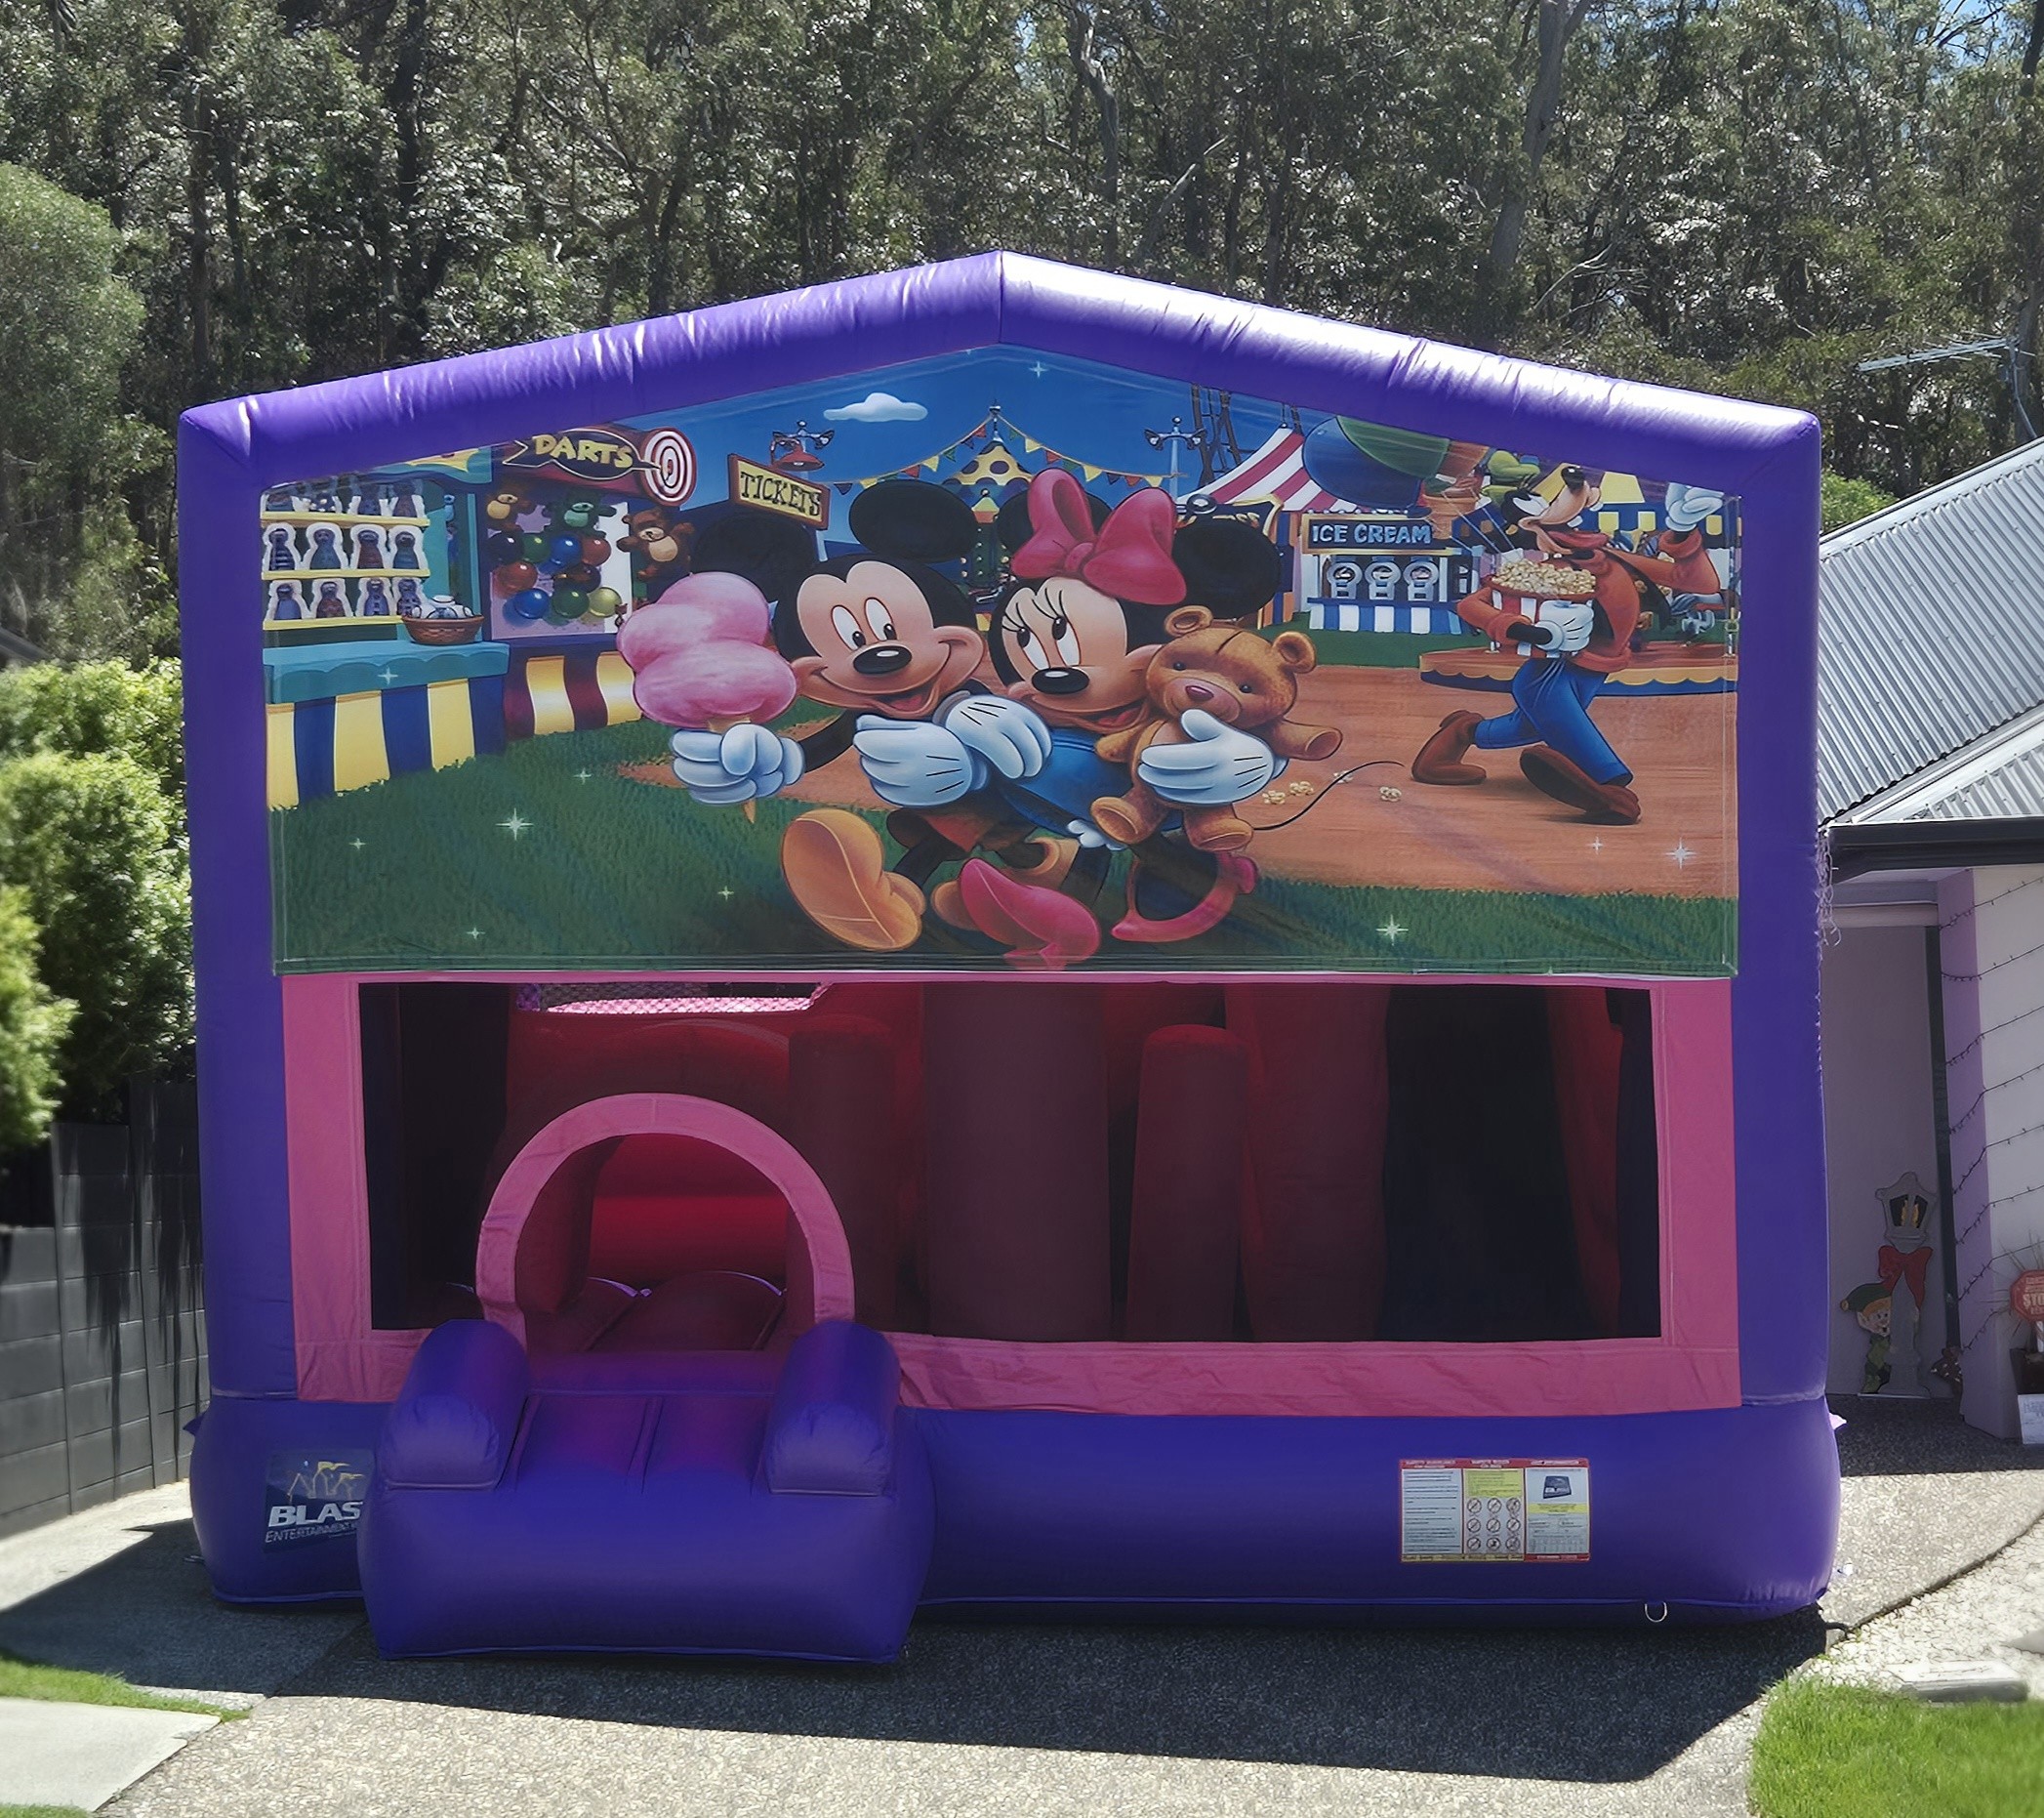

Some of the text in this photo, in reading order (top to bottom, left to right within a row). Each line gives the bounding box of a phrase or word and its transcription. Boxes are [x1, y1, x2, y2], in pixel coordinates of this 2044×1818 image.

[532, 434, 634, 469] DARTS
[740, 471, 822, 516] TICKETS
[1312, 522, 1432, 545] ICE CREAM
